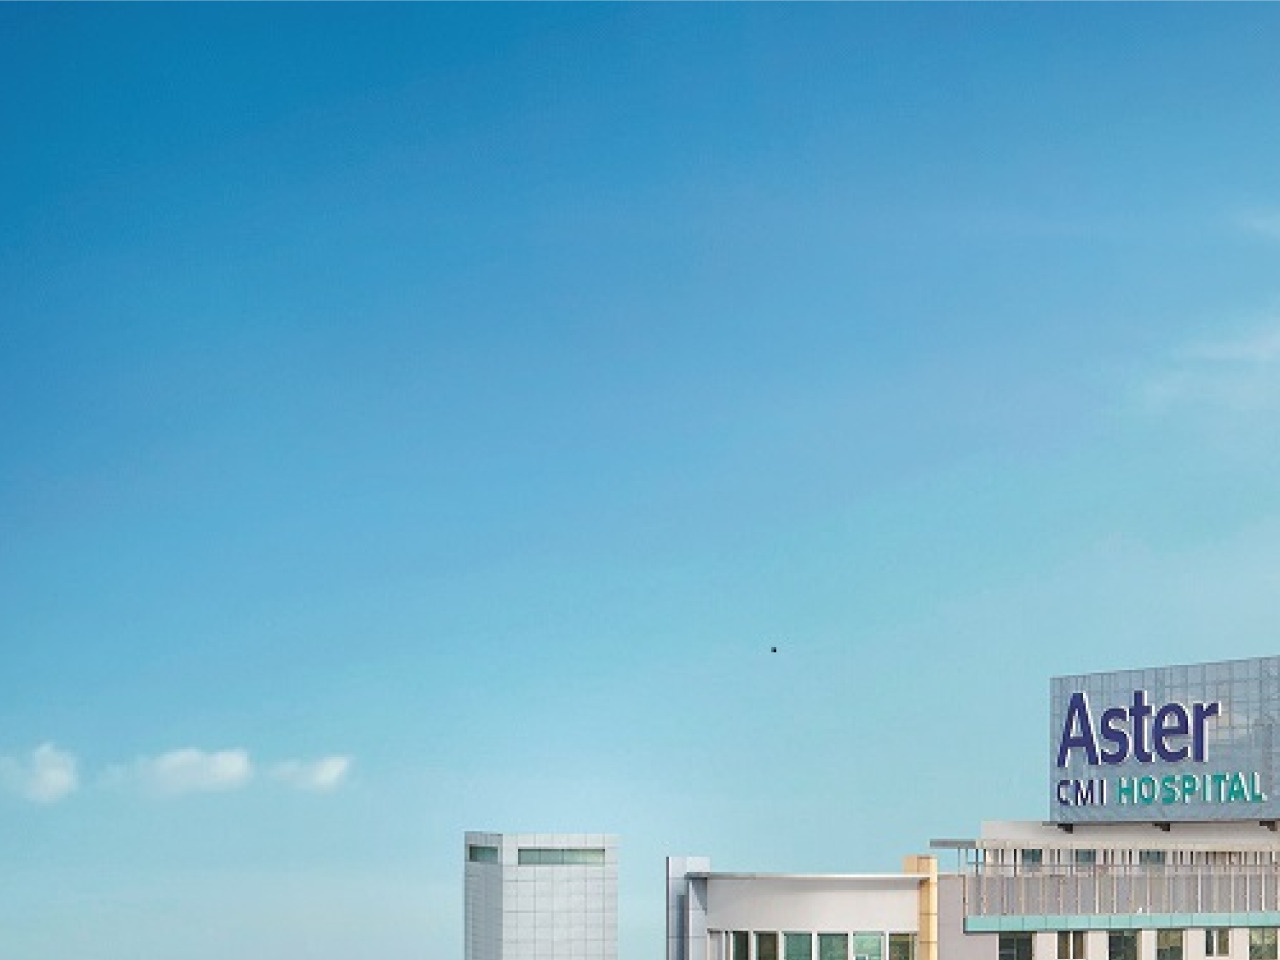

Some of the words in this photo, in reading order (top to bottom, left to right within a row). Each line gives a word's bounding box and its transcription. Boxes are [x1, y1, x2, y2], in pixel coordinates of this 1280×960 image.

[1057, 690, 1222, 768] Aster
[1057, 779, 1107, 807] CMI
[1116, 771, 1267, 805] HOSPITAL
